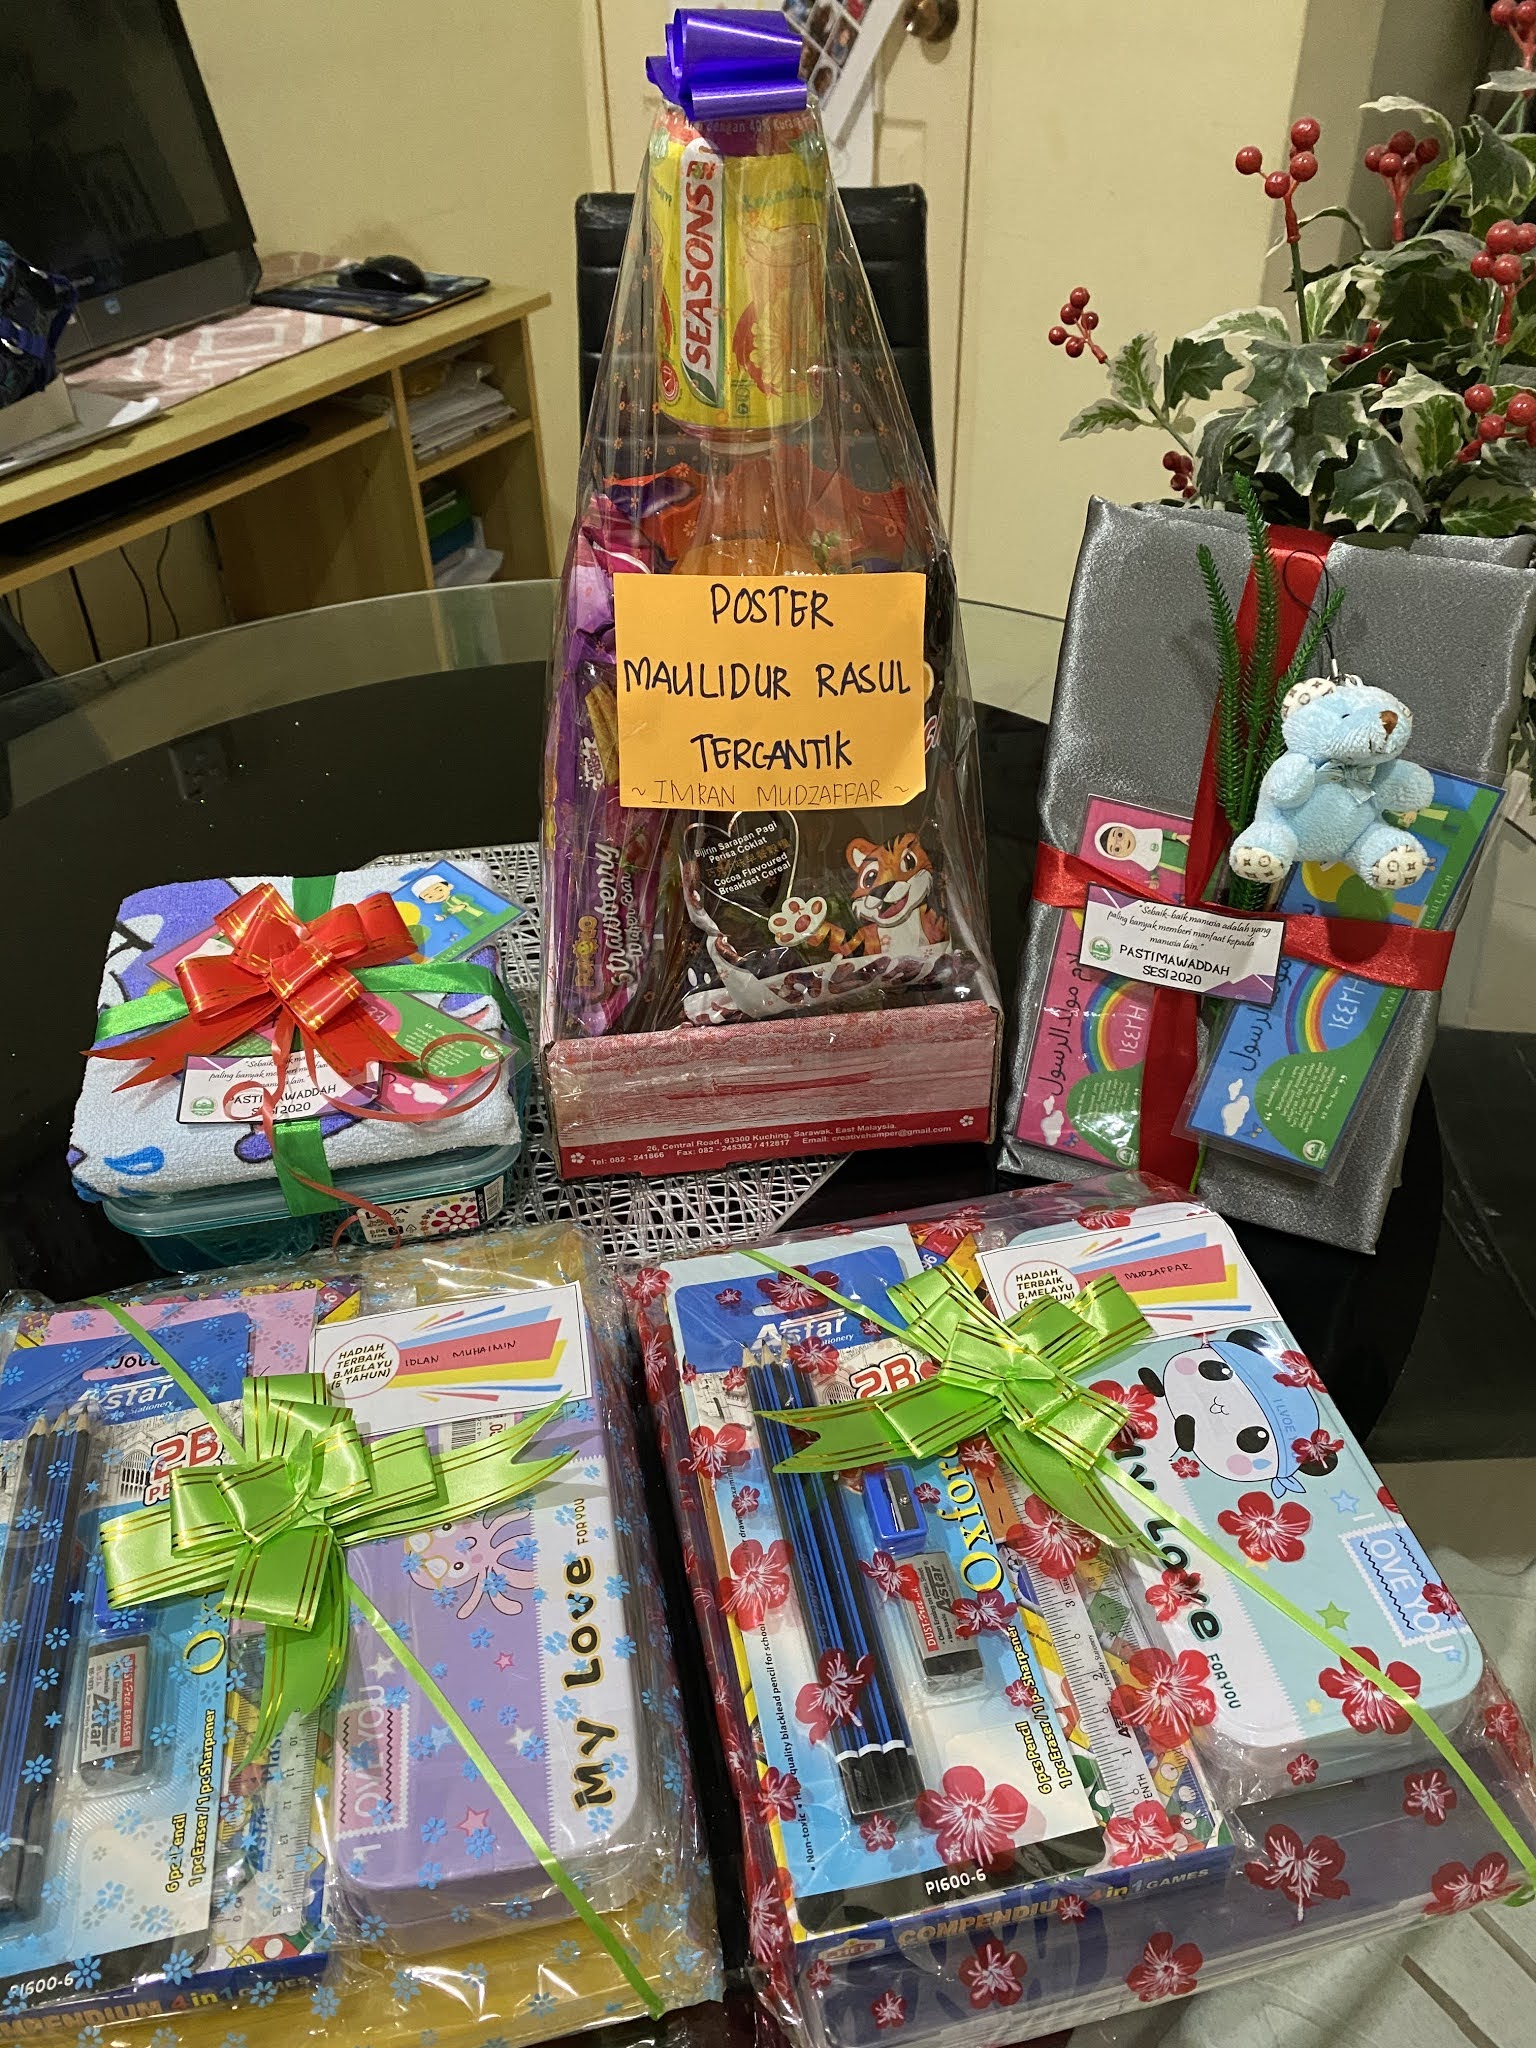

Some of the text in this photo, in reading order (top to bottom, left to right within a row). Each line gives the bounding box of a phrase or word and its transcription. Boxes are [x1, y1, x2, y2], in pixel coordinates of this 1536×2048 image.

[685, 182, 714, 369] SEASONS
[710, 583, 834, 629] POSTER
[624, 656, 911, 700] MAULIDUR RASUL
[652, 780, 882, 806] IMRAN MUDZAFFAR
[694, 820, 777, 858] Bijirin Sarapan Pagi
[709, 836, 767, 863] Perisa Coklat
[714, 873, 741, 887] Cocoa
[742, 852, 788, 877] Flavoured
[719, 861, 791, 895] Breakfast Cereal
[1107, 911, 1255, 949] paling banyak memberi manfaat kepada
[1189, 917, 1220, 928] manusia
[1222, 920, 1250, 932] adalah
[1251, 926, 1272, 938] yang
[1150, 936, 1181, 948] manusia
[1142, 965, 1202, 985] SESI 2020
[209, 1068, 265, 1081] paling banyak
[230, 1085, 337, 1105] ASTI AWADDAH
[280, 1102, 311, 1115] 2020
[591, 1158, 607, 1166] Tel:
[610, 1156, 625, 1164] 082
[633, 1152, 664, 1161] 241866
[677, 1148, 695, 1156] Fax:
[698, 1146, 714, 1154] 082
[722, 1142, 752, 1152] 245392
[759, 1139, 790, 1148] 412817
[802, 1135, 829, 1145] Email:
[646, 1146, 660, 1154] 26,
[662, 1141, 694, 1150] Central
[724, 1135, 750, 1144] 93300
[836, 1126, 855, 1134] East
[1015, 1268, 1058, 1281] HADIAH
[1017, 1277, 1063, 1290] TERBAIK
[337, 1351, 386, 1368] TERBAIK
[338, 1342, 384, 1359] HADIAH
[333, 1360, 392, 1379] B.MELAYU
[345, 1368, 391, 1385] TAHUN)
[855, 1357, 917, 1399] 2B
[129, 1400, 175, 1414] Stationery
[153, 1426, 220, 1481] 2B
[574, 1498, 585, 1520] YOU
[576, 1522, 589, 1546] FOR
[759, 1622, 772, 1651] school
[936, 1625, 945, 1641] Clean
[765, 1652, 775, 1667] for
[768, 1666, 781, 1694] pencil
[1208, 1654, 1228, 1681] FOR
[1223, 1682, 1242, 1709] YOU
[121, 1709, 133, 1742] ERASER
[772, 1693, 790, 1739] blacklead
[199, 1708, 216, 1778] Sharpener
[1016, 1721, 1039, 1760] Pencil
[784, 1742, 799, 1776] quality
[1038, 1784, 1052, 1795] 6
[191, 1814, 208, 1858] Eraser
[800, 1811, 816, 1863] Non-toxic
[165, 1881, 179, 1893] 6
[925, 1868, 987, 1896] PI600-6
[898, 1898, 1062, 1948] COMPENDIU
[1105, 1884, 1129, 1899] in
[1146, 1868, 1209, 1889] GAMES
[191, 1990, 218, 2007] in
[238, 1976, 311, 1998] GMES
